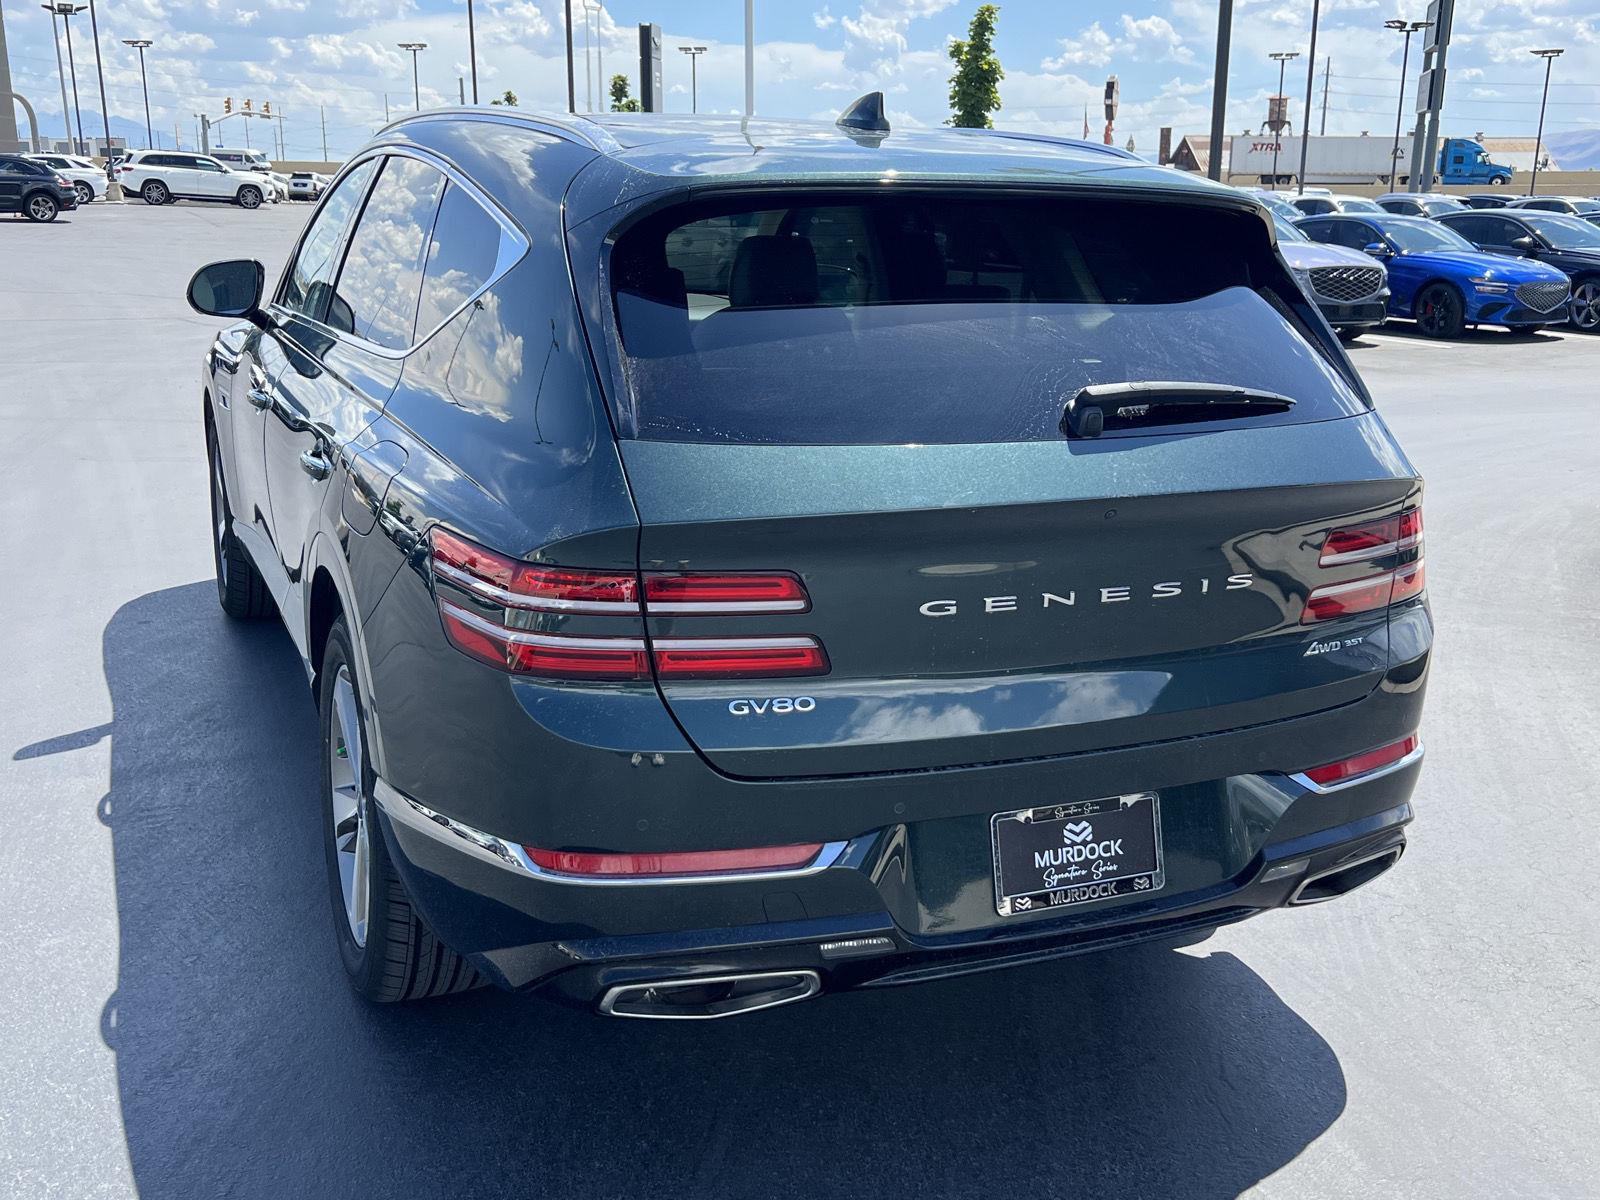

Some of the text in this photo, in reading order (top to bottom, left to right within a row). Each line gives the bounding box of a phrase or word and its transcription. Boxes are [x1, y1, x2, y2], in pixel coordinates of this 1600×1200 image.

[1248, 142, 1281, 153] XTRA
[919, 573, 1253, 616] GENESIS
[728, 696, 816, 715] GV80
[1034, 838, 1124, 868] MURDOCK
[1043, 859, 1118, 888] Signature Series
[1050, 881, 1118, 905] MURDOCK
